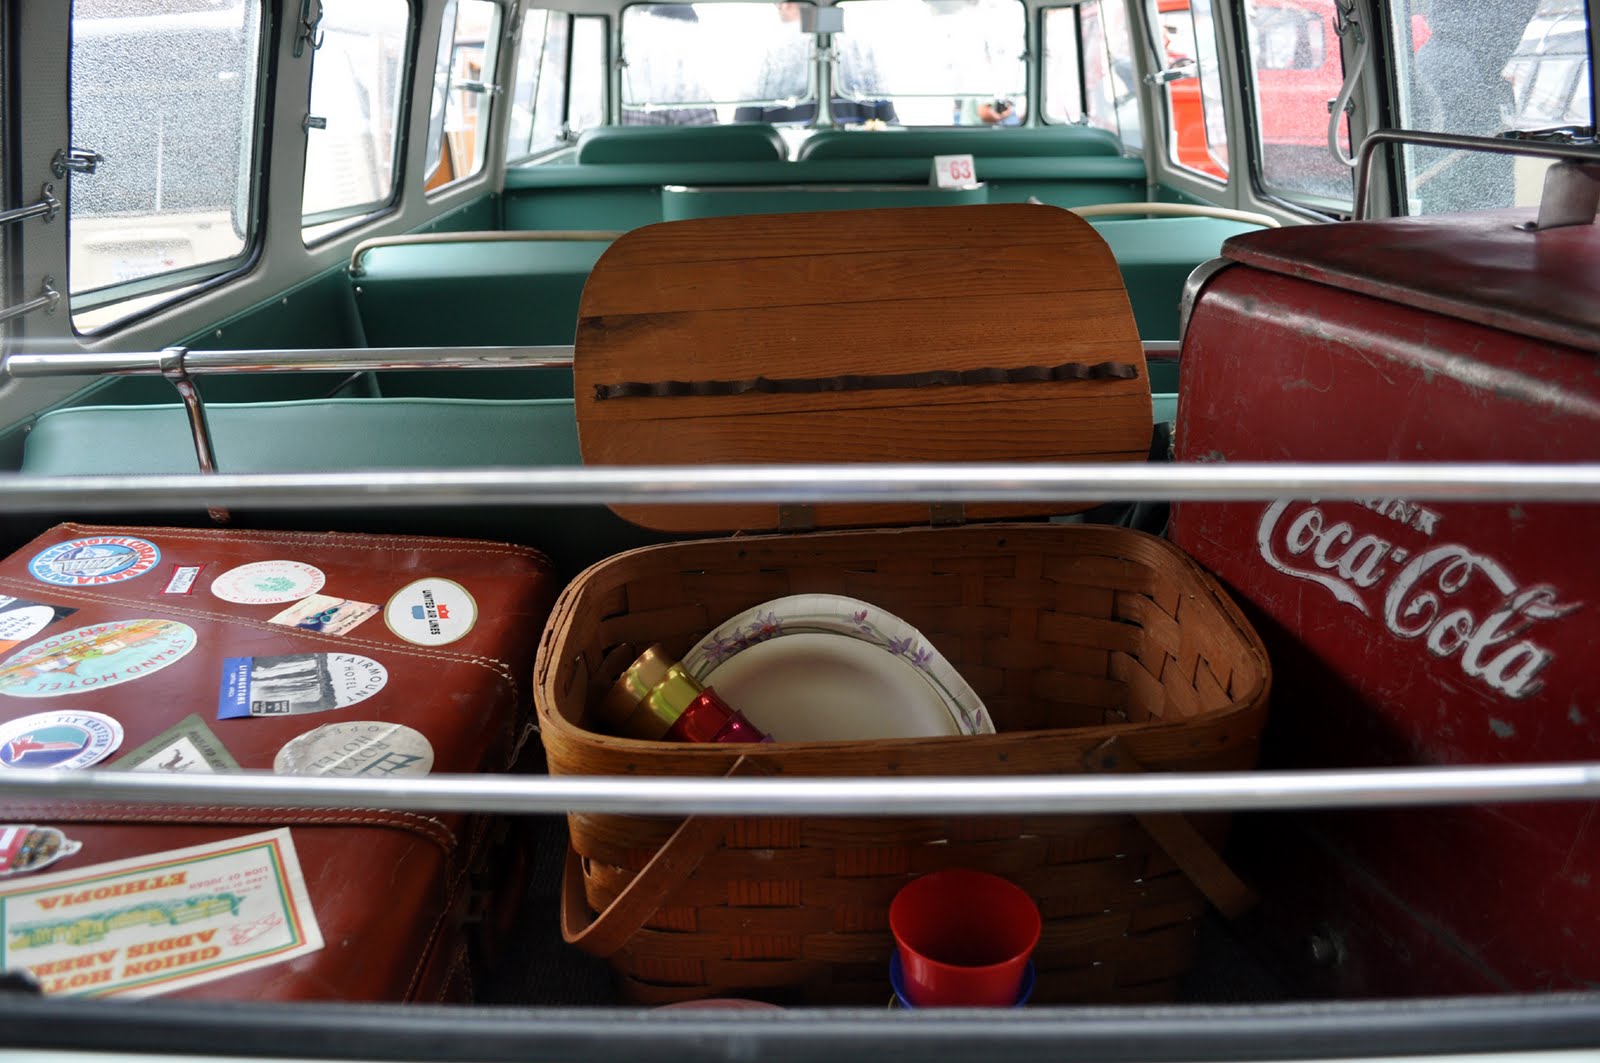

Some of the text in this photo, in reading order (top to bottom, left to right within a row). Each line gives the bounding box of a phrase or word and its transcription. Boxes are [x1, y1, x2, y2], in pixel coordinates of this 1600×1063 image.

[950, 160, 971, 180] 63
[73, 538, 157, 584] HOTEL COPACABANA
[423, 590, 441, 635] UNITED AIR LINES
[1257, 497, 1584, 700] Coca-Cola
[16, 623, 127, 664] RANGOON
[36, 639, 188, 692] STRAND HOTEL
[237, 665, 248, 705] LIVINGSTONE
[335, 655, 382, 703] FAIRMOUNT
[343, 666, 357, 690] HOTEL
[306, 735, 373, 773] HOTEL
[35, 870, 188, 912] ETHIOPIA
[122, 945, 221, 978] GHION
[126, 928, 219, 959] ADDIS
